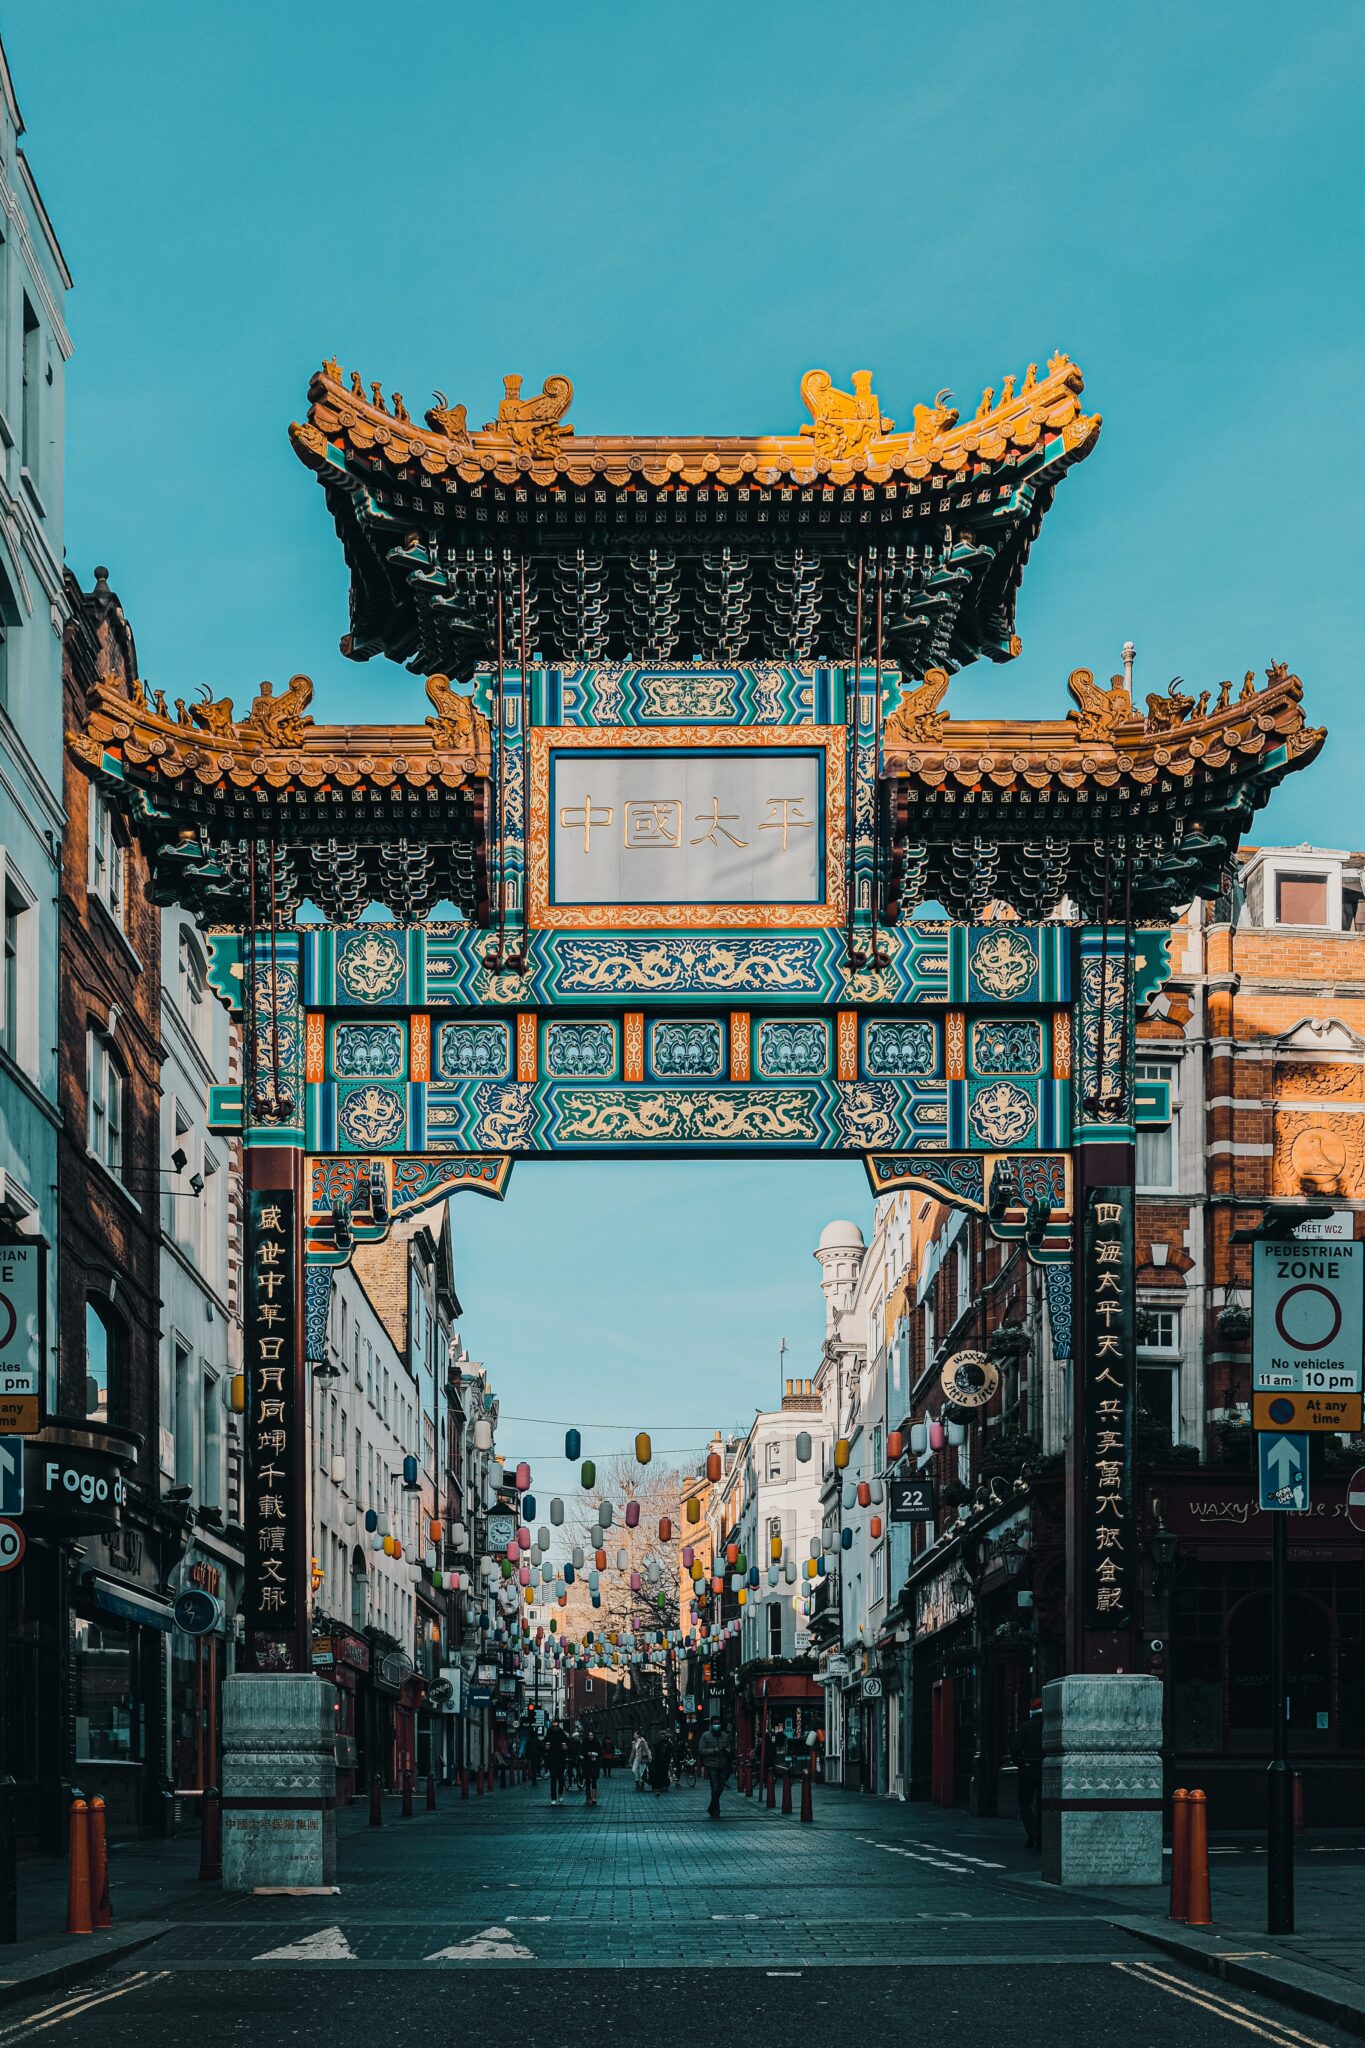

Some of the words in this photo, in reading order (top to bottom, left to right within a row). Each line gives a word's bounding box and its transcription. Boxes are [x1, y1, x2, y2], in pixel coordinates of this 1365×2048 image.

[559, 794, 815, 854] 中國太平
[1324, 1225, 1343, 1234] WC2
[1265, 1246, 1353, 1257] PEDESTRIAN
[1277, 1261, 1340, 1279] ZONE
[1271, 1358, 1289, 1369] No
[1293, 1358, 1345, 1370] vehicles
[5, 1378, 30, 1391] pm
[1260, 1374, 1270, 1385] 11
[1273, 1377, 1292, 1386] am
[1305, 1372, 1325, 1387] 10
[1329, 1376, 1354, 1389] pm
[1, 1404, 24, 1415] any
[1306, 1399, 1321, 1411] At
[1325, 1402, 1347, 1413] any
[1312, 1413, 1341, 1424] time
[45, 1462, 109, 1504] Fogo
[113, 1476, 127, 1508] de
[901, 1490, 923, 1506] 22
